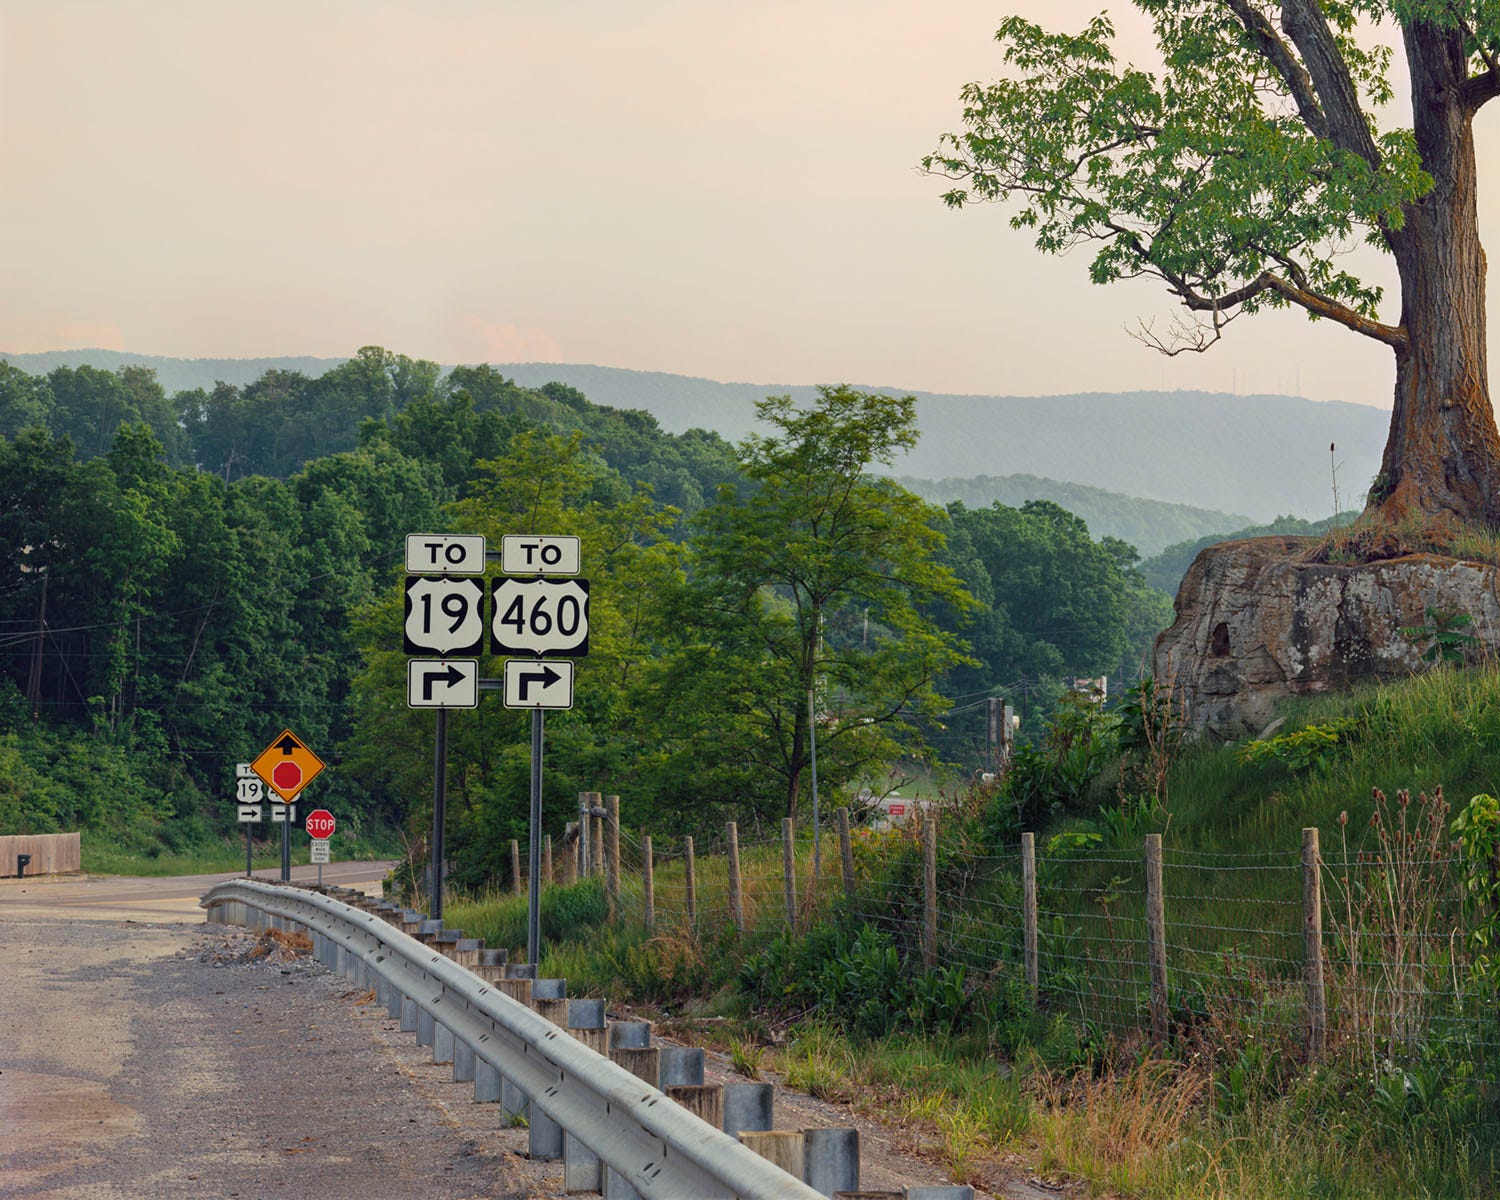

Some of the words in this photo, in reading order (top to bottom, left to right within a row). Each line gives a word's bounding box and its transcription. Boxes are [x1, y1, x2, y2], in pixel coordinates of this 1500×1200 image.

[424, 543, 467, 564] TO
[520, 544, 562, 565] TO
[421, 593, 468, 634] 19
[501, 594, 580, 636] 460
[241, 783, 258, 797] 19
[307, 818, 334, 830] STOP
